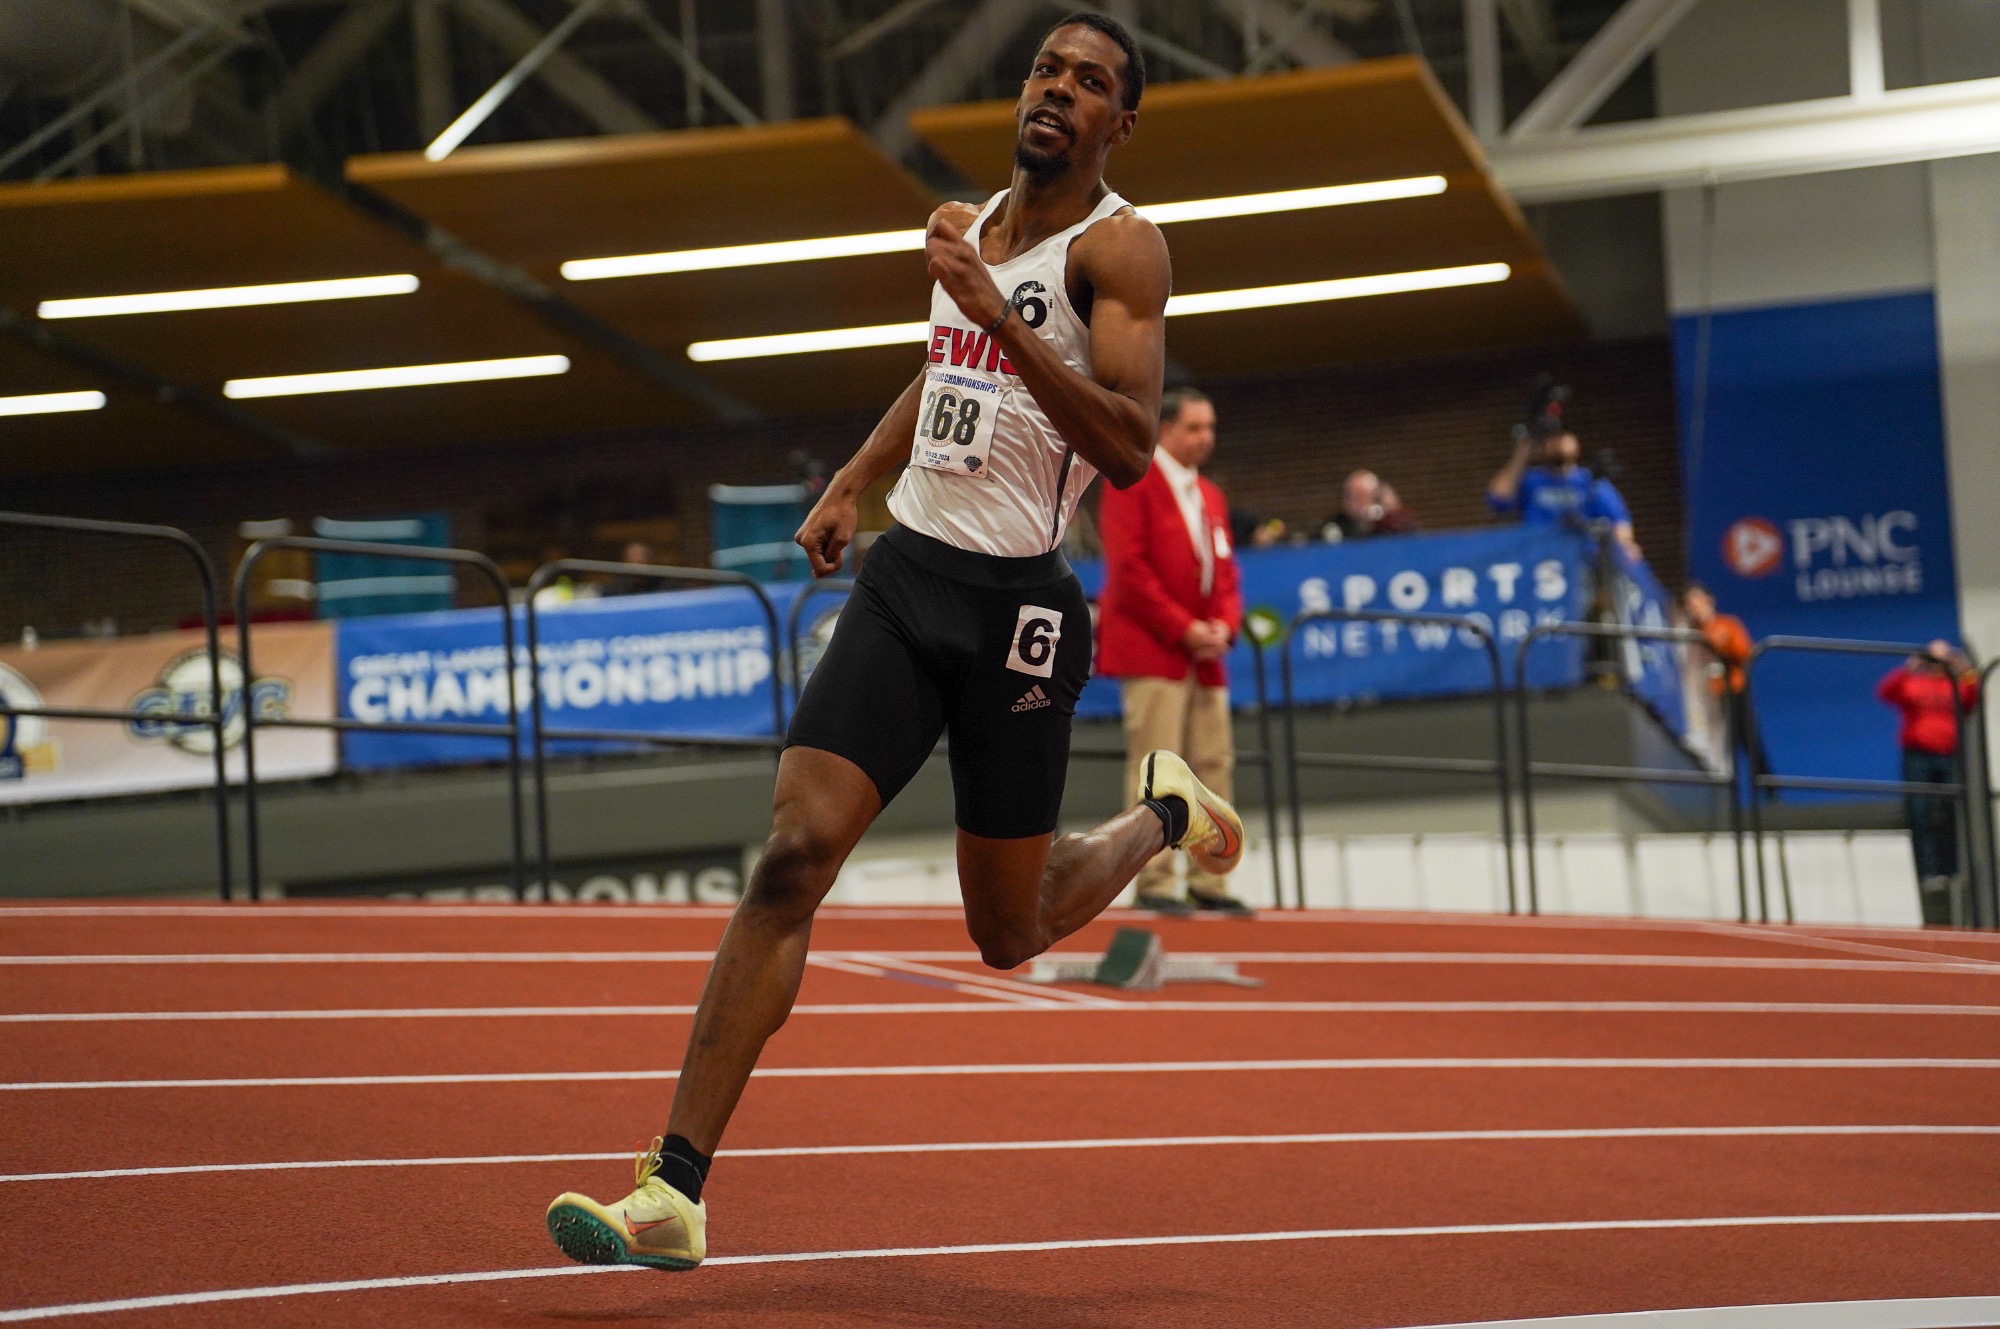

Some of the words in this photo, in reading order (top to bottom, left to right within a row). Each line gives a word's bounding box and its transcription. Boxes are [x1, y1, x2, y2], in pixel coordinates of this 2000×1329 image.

[1012, 281, 1047, 329] 6
[944, 373, 998, 394] CHAMPIONSHIPS
[920, 391, 981, 446] 268
[1792, 510, 1917, 566] PNC
[1299, 560, 1567, 613] SPORTS
[1018, 618, 1054, 666] 6
[1304, 608, 1565, 657] NETWORK
[1011, 699, 1051, 712] adidas
